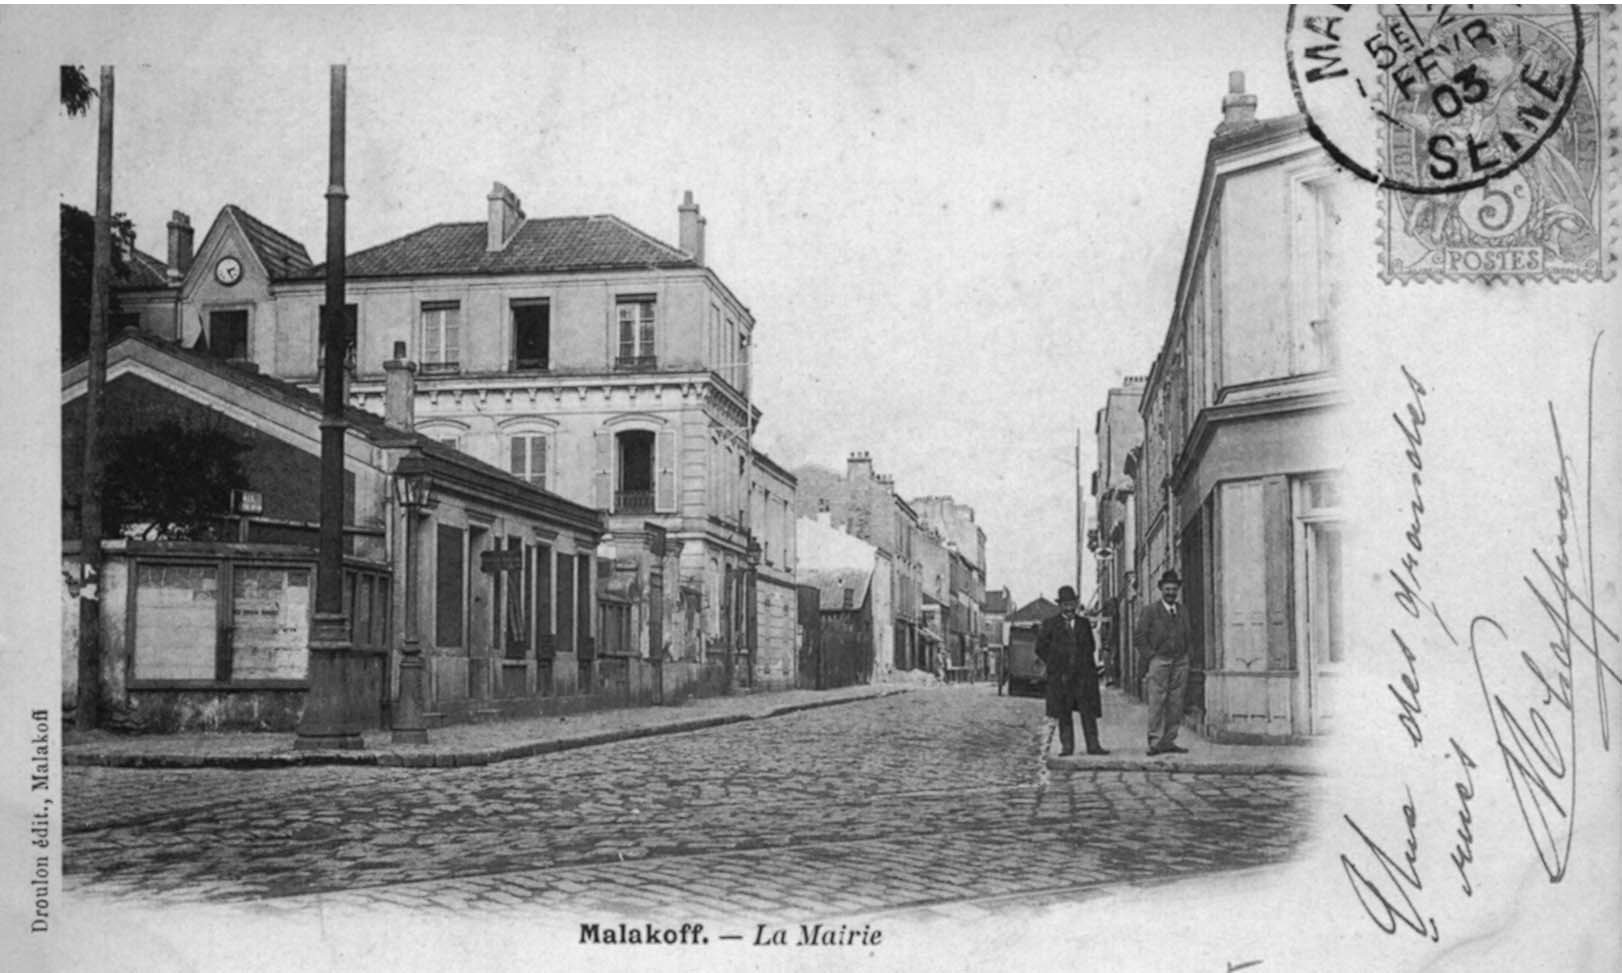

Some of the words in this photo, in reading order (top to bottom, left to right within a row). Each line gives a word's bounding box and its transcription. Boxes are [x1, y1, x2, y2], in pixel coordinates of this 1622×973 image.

[1431, 63, 1489, 119] 03
[1448, 251, 1541, 271] POSTES
[1390, 365, 1459, 646] grandes
[1388, 628, 1424, 749] des
